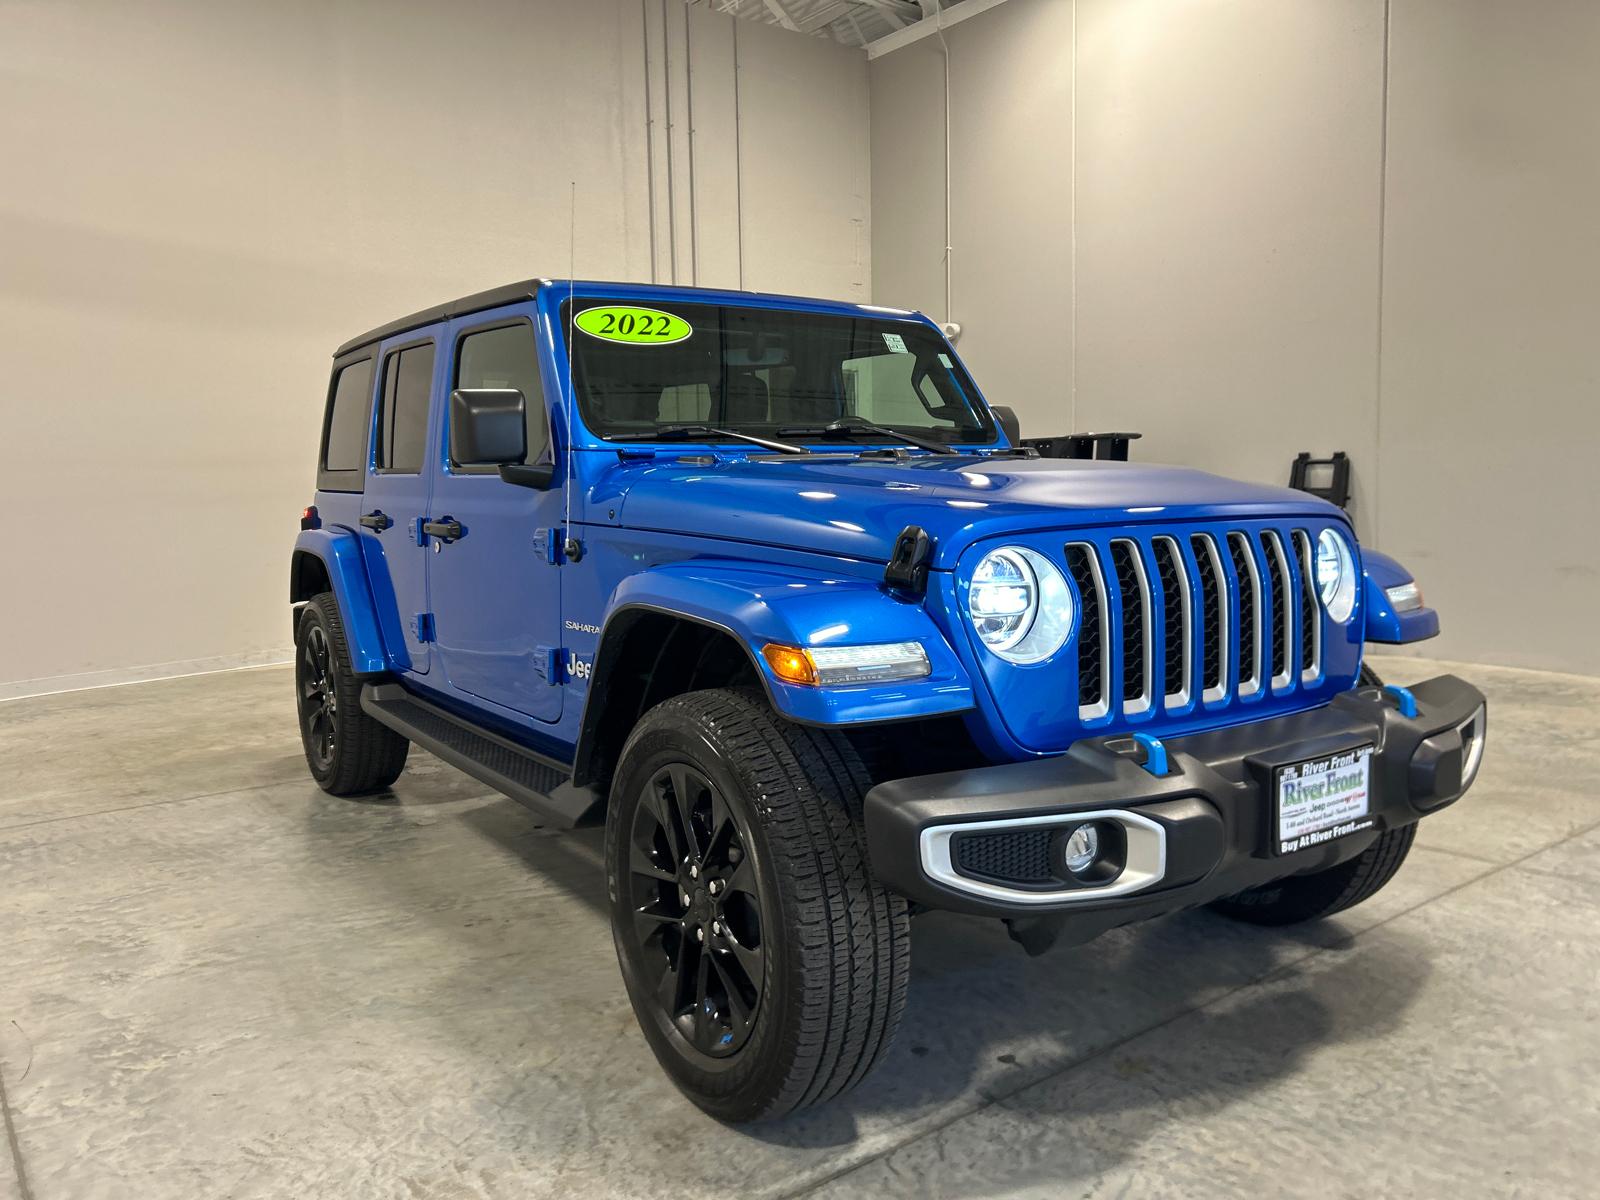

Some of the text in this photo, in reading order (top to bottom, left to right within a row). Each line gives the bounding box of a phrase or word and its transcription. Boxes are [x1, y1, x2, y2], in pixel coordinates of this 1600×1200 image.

[598, 313, 671, 336] 2022
[565, 620, 601, 635] SAHARA
[567, 652, 592, 680] Jee
[1302, 762, 1329, 777] River
[1330, 753, 1355, 769] Front
[1309, 802, 1326, 813] Jeep
[1281, 840, 1298, 853] Buy
[1299, 836, 1310, 847] At
[1310, 830, 1333, 844] River
